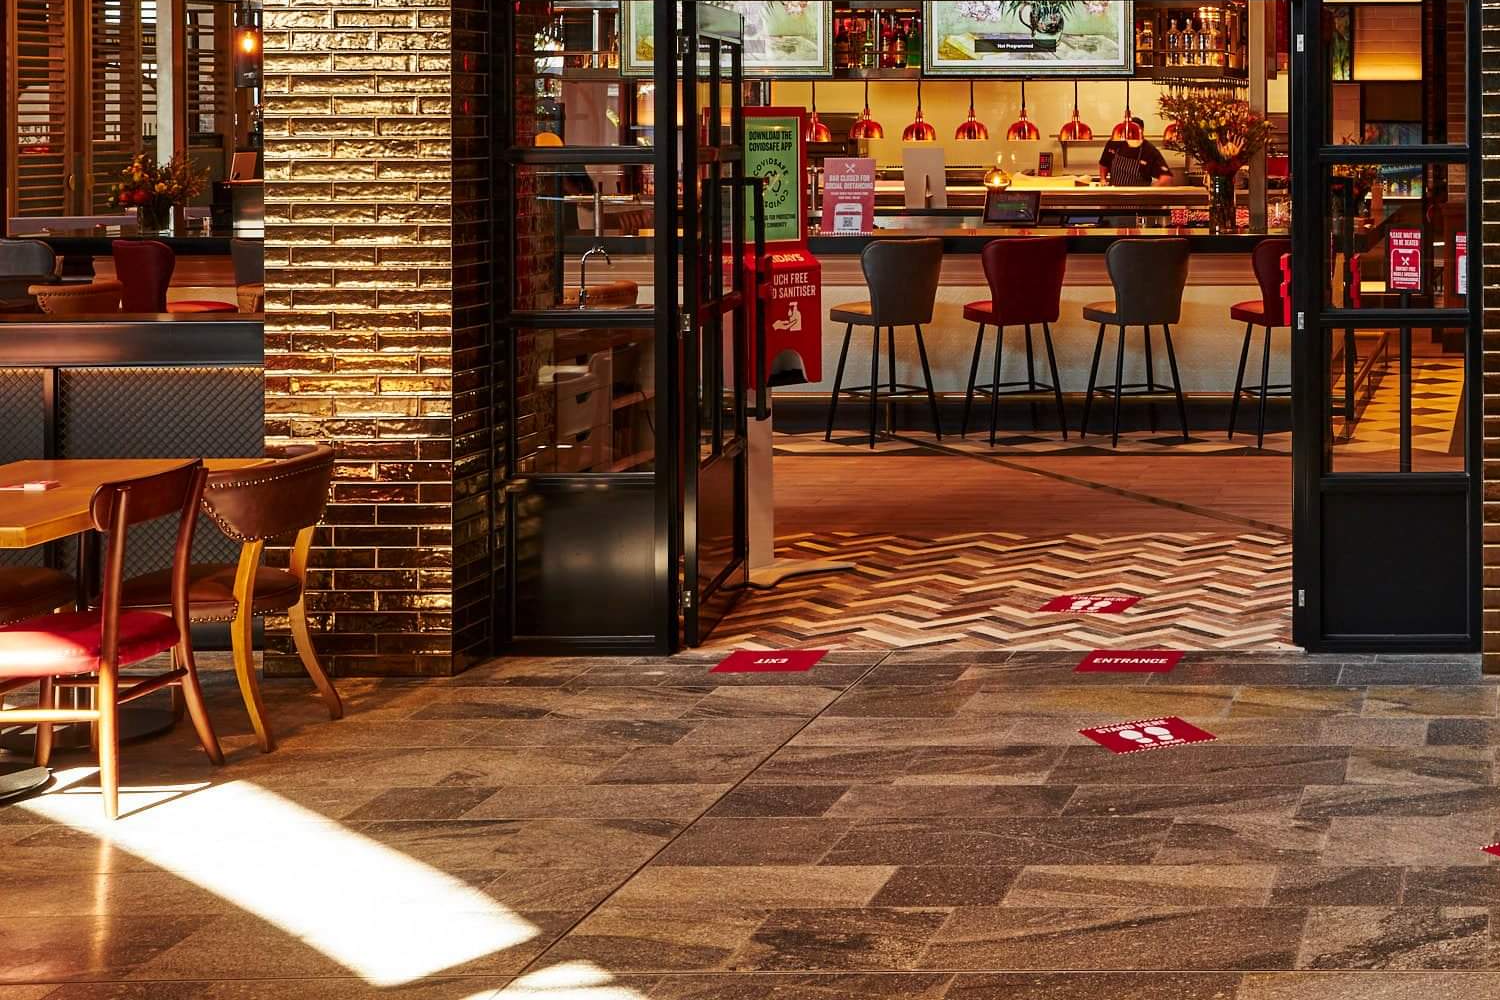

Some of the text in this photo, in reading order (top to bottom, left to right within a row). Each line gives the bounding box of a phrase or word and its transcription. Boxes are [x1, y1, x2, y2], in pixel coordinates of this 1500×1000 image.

[749, 130, 792, 140] DOWNLOAD THE
[749, 142, 793, 152] COVIDSAFE APP
[753, 157, 789, 176] COVIDSAFE
[772, 253, 804, 264] IDAYS
[773, 272, 809, 286] UCH FREE
[779, 285, 816, 299] SANITISER
[1095, 719, 1169, 735] STAND HERE
